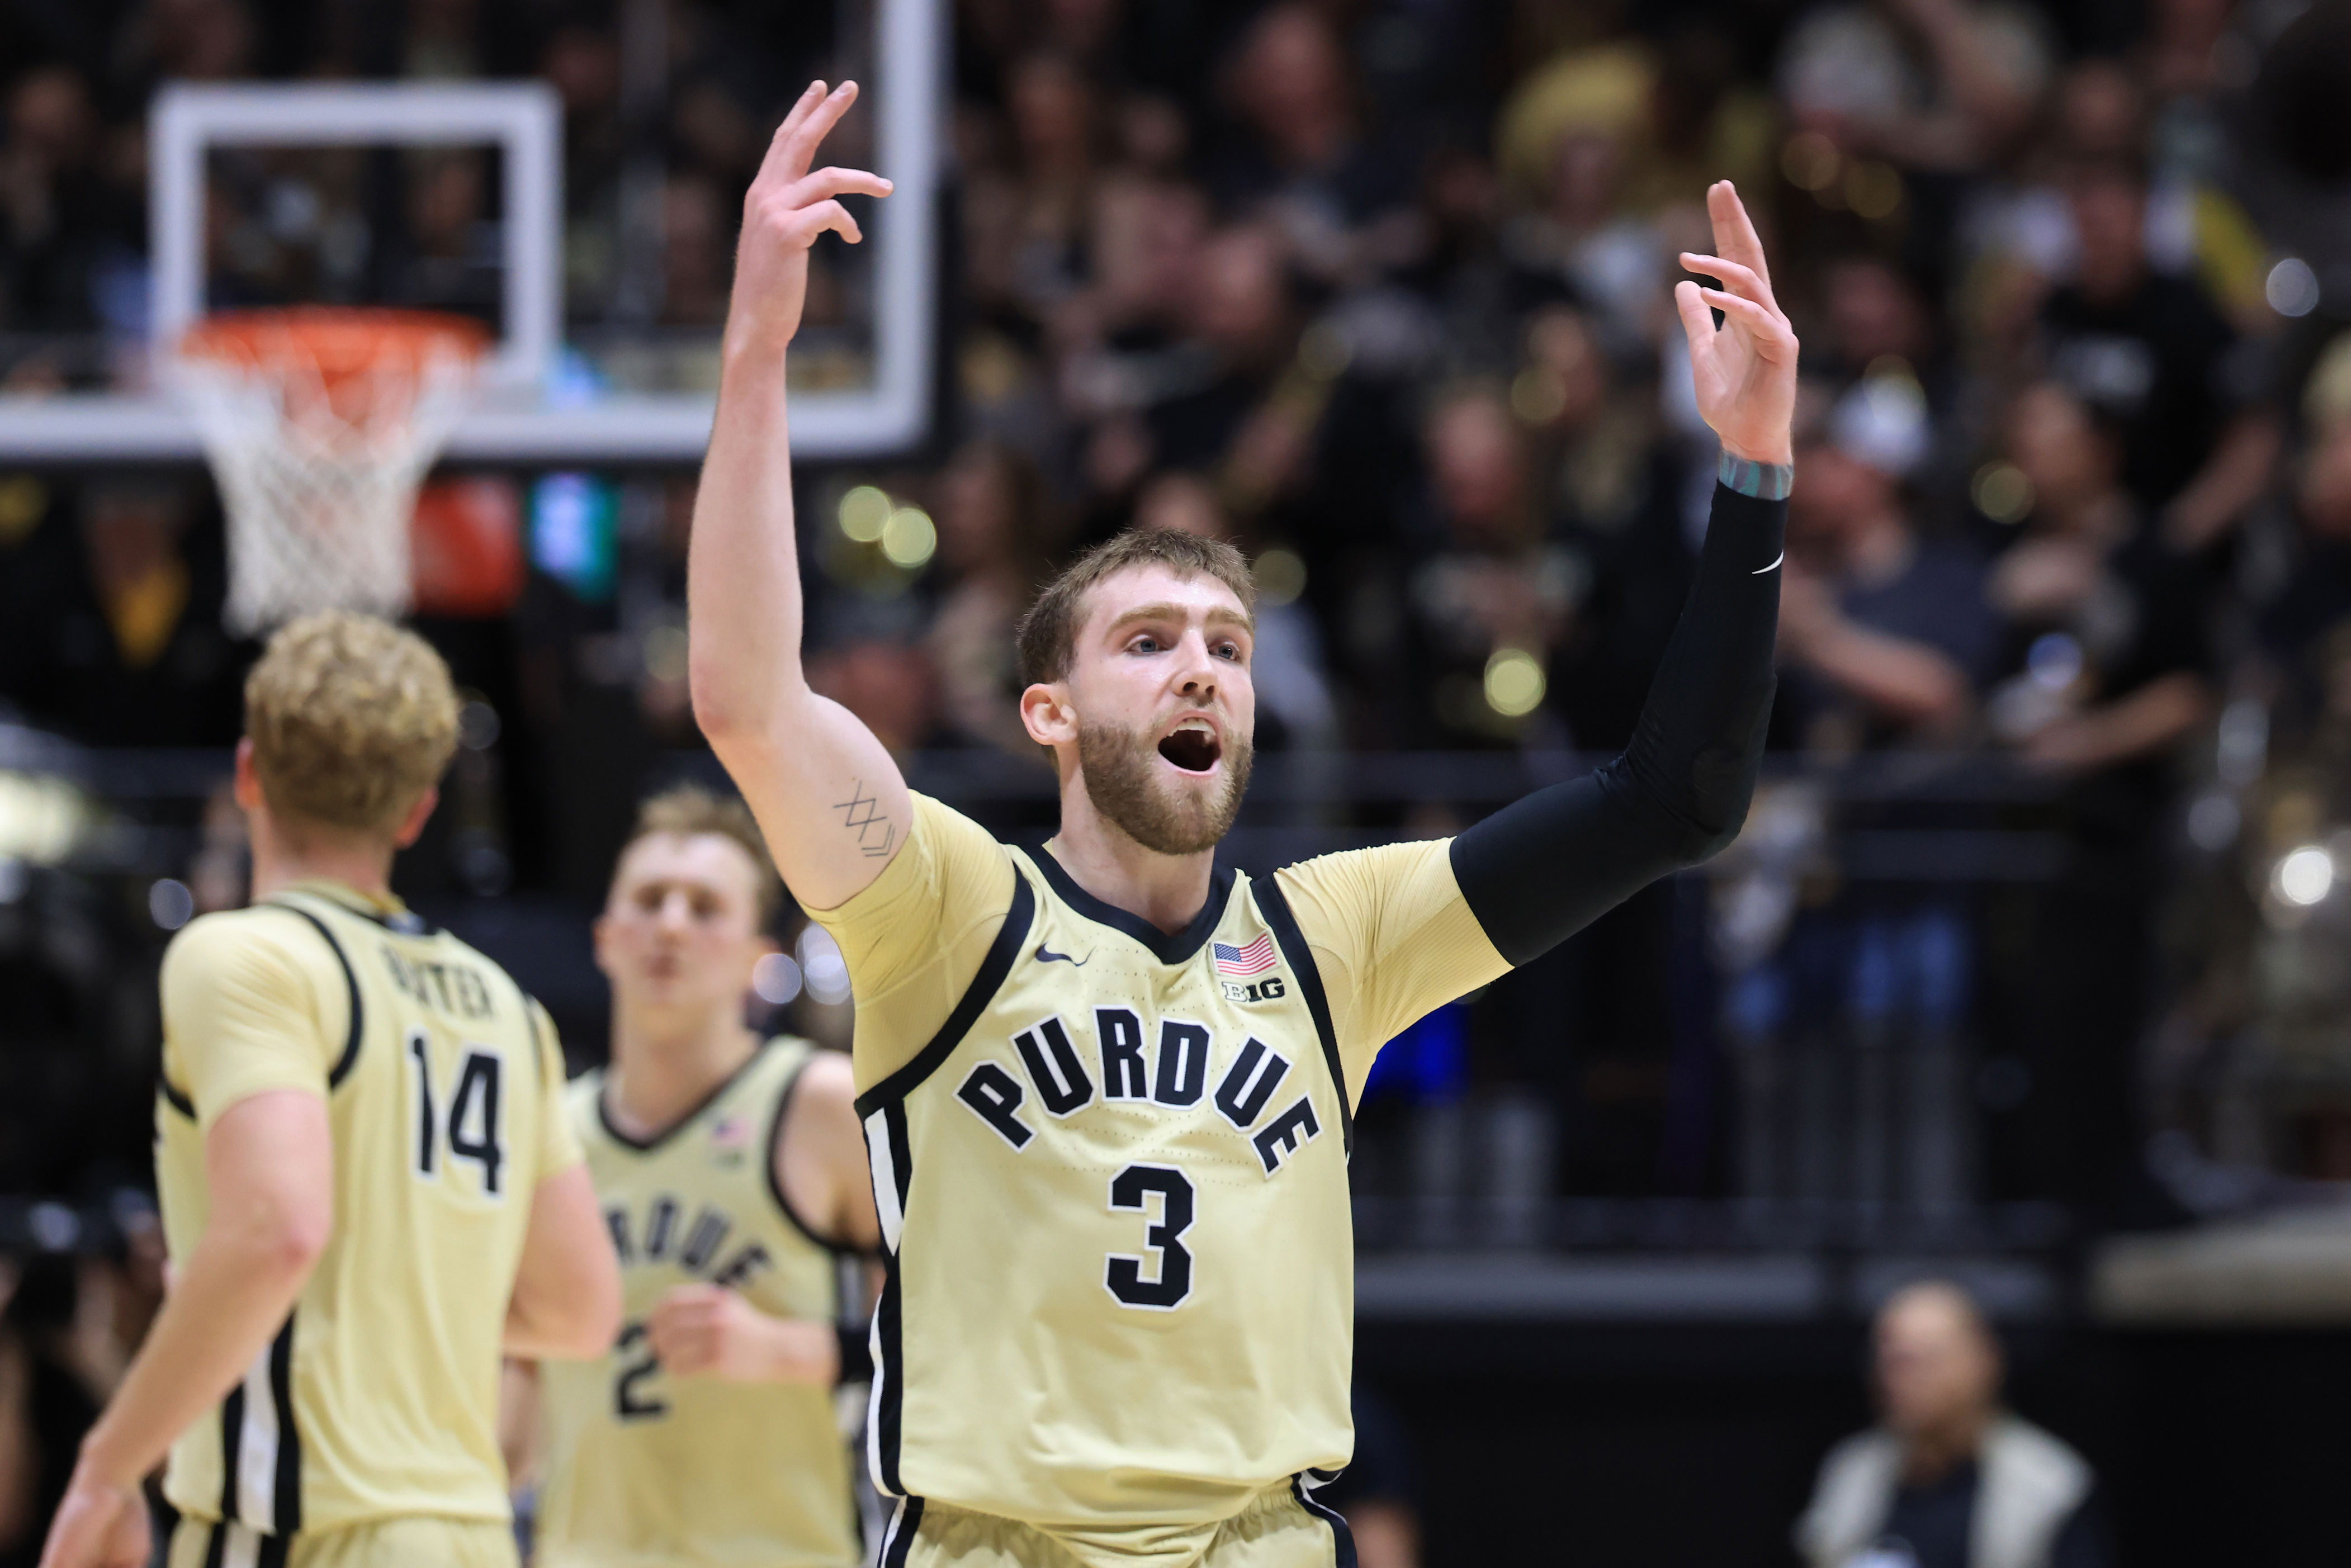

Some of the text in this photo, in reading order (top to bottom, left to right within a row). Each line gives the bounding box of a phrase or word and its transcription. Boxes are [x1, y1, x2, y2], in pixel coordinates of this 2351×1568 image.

[408, 1031, 506, 1200] 14
[952, 1005, 1323, 1180] PURDUE
[1103, 1160, 1197, 1312] 3
[615, 1319, 669, 1419] 2
